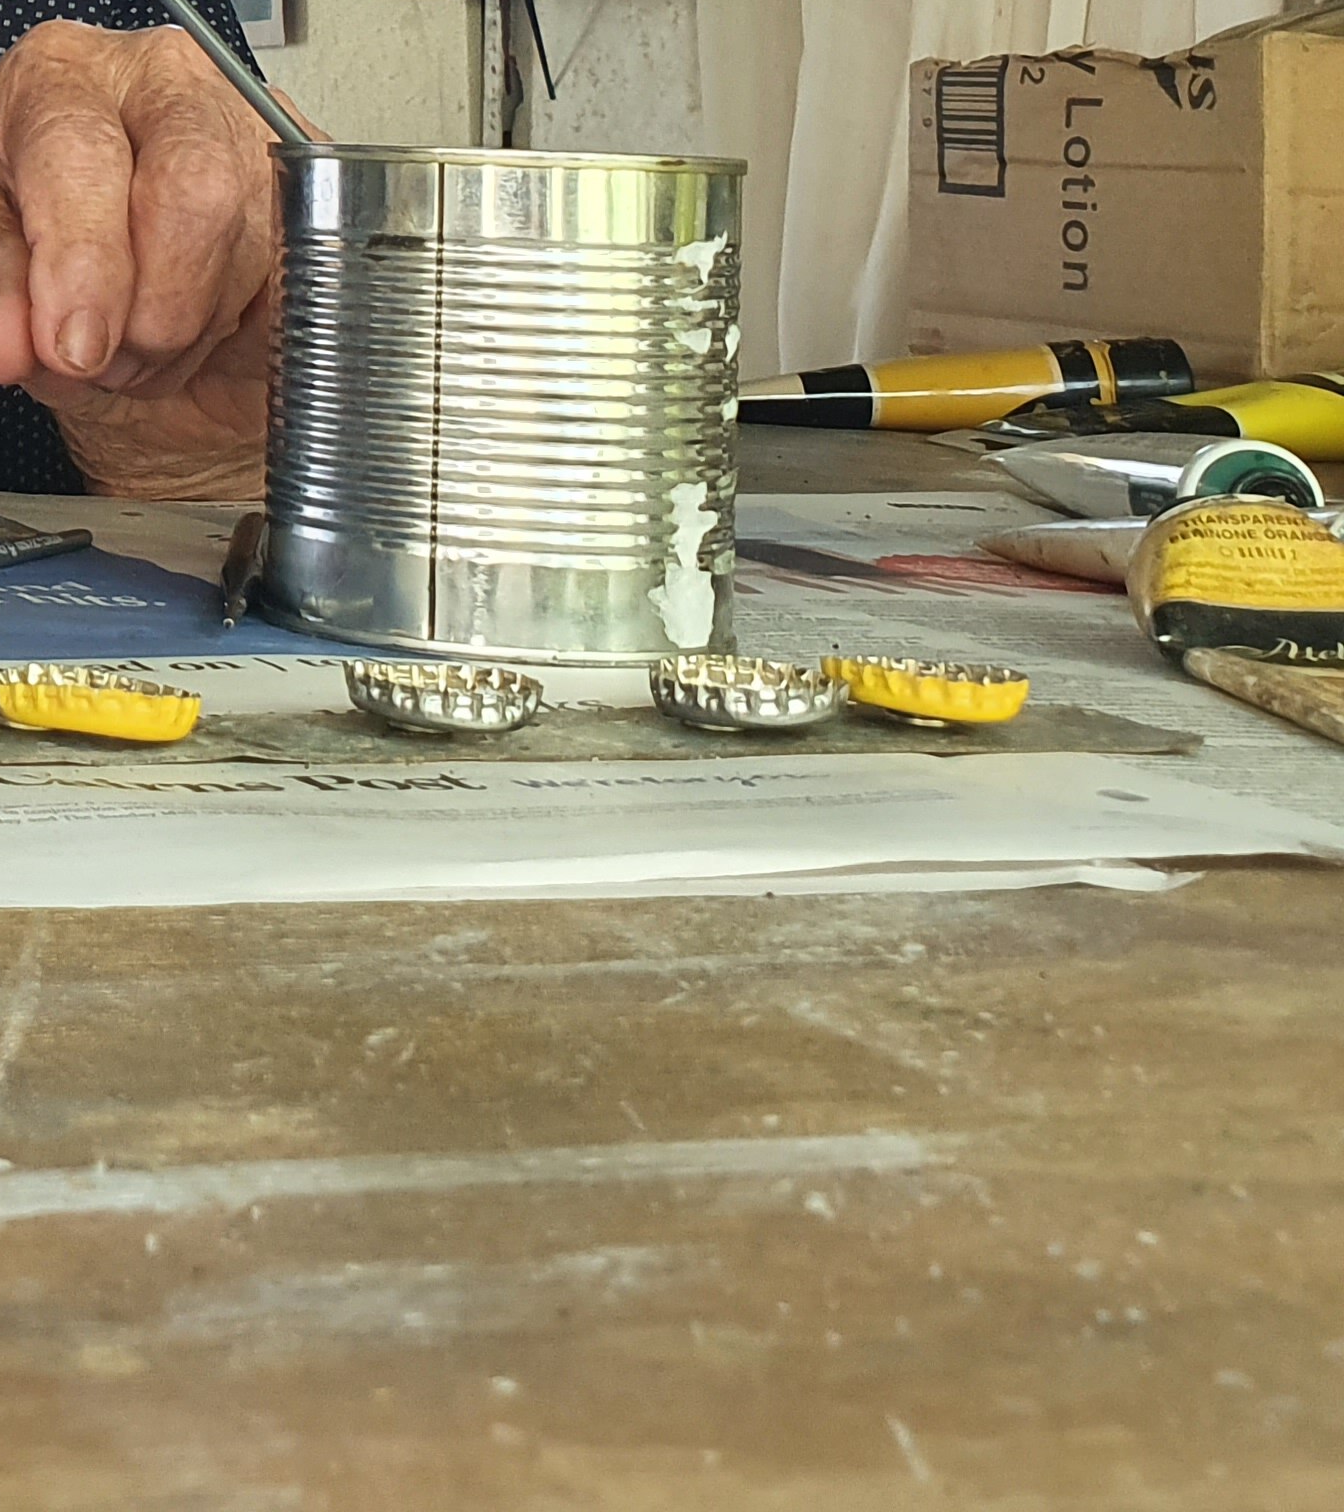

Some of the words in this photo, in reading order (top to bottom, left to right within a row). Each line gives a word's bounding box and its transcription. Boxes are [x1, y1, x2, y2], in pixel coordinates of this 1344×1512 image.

[1187, 54, 1218, 111] S
[1062, 97, 1104, 292] Lotion
[1178, 513, 1309, 528] TRANSPARENT
[168, 660, 245, 672] on
[286, 772, 488, 791] Post
